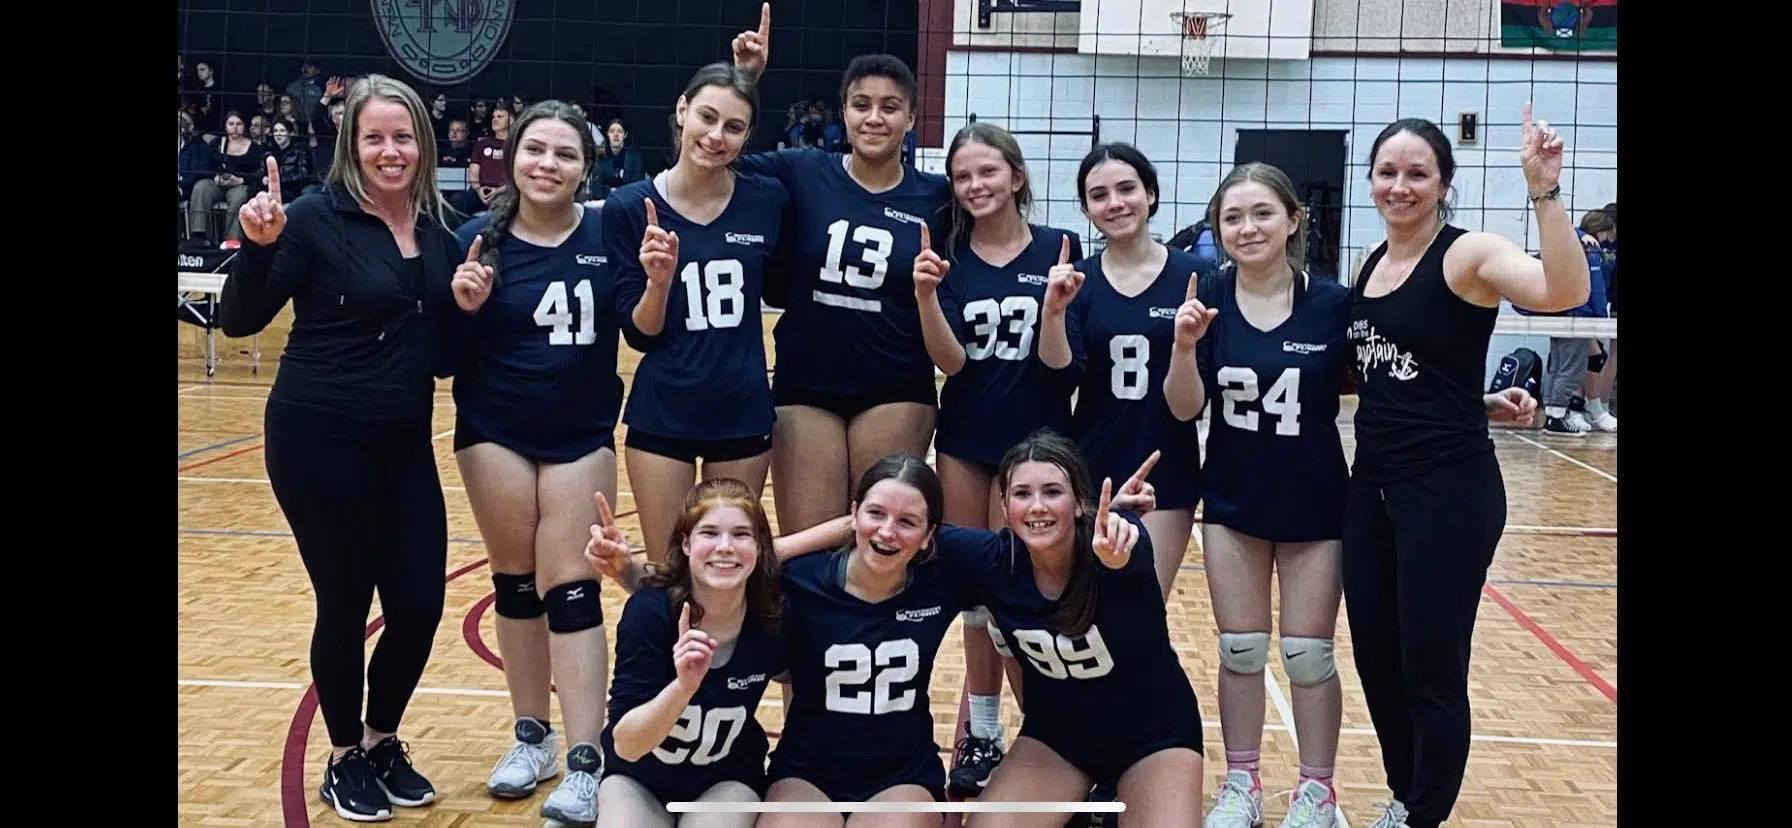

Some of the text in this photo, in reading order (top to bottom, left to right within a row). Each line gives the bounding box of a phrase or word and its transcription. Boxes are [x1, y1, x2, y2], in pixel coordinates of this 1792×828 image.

[178, 253, 204, 267] lten
[819, 220, 894, 289] 13
[533, 280, 597, 345] 41
[681, 259, 745, 331] 18
[963, 296, 1039, 361] 33
[1110, 335, 1149, 400] 8
[1217, 366, 1301, 436] 24
[825, 639, 920, 715] 22
[1012, 624, 1115, 680] 99
[651, 705, 747, 765] 20
